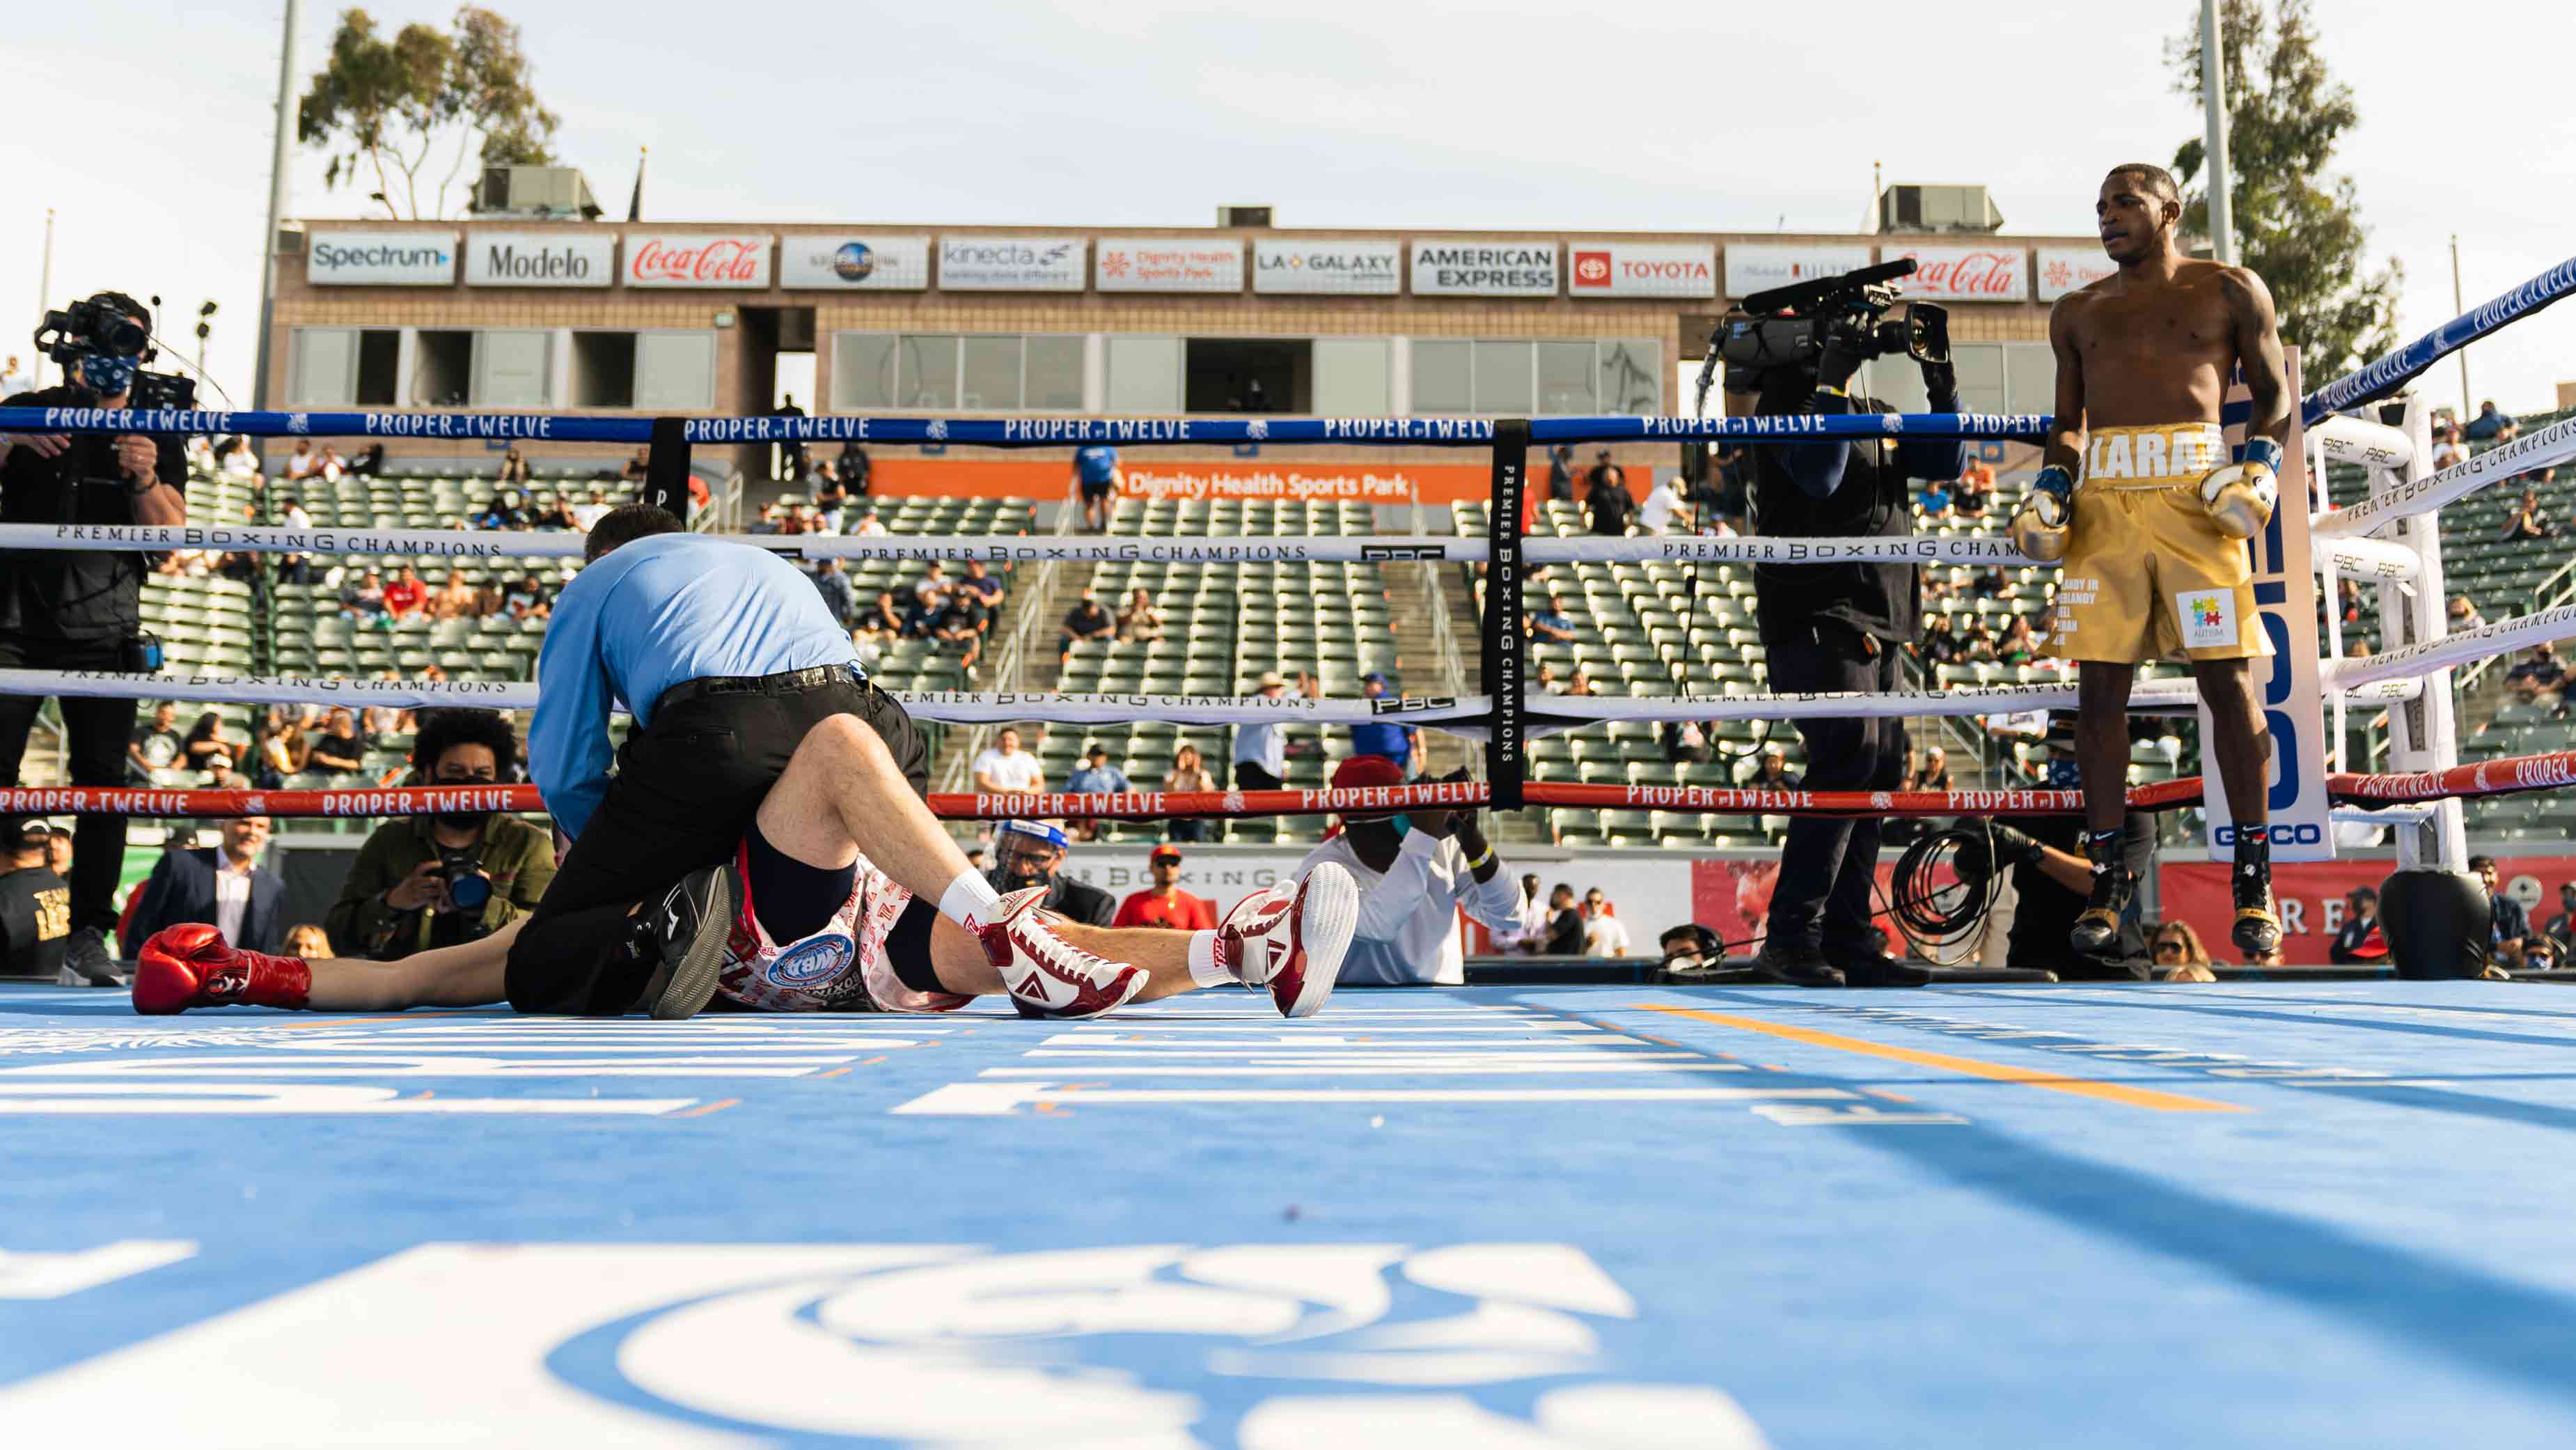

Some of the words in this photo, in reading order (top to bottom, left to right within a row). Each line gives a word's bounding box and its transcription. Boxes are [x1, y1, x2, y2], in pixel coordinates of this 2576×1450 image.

[314, 244, 440, 270] Spectrum
[487, 244, 590, 279] Modelo
[943, 241, 1035, 265] kinecta
[1258, 255, 1286, 271] LA
[1308, 255, 1395, 271] GALAXY
[1418, 249, 1552, 267] AMERICAN
[1437, 270, 1555, 287] EXPRESS
[1621, 262, 1709, 279] TOYOTA
[45, 408, 133, 430] PROPER
[144, 411, 232, 432] TWELVE
[366, 413, 452, 435] PROPER
[464, 415, 551, 437] TWELVE
[684, 418, 770, 441] PROPER
[782, 417, 870, 439] TWELVE
[1004, 418, 1091, 439] PROPER
[1103, 418, 1191, 439] TWELVE
[1324, 418, 1411, 437] PROPER
[1421, 418, 1495, 439] TWELV
[1642, 416, 1728, 435] PROPER
[1741, 414, 1826, 434] TWELVE
[1957, 412, 2041, 433] PROPER
[1129, 472, 1207, 499] Dignity
[1211, 472, 1285, 495] Health
[1288, 474, 1360, 499] Sports
[1364, 474, 1408, 495] Park
[2405, 457, 2483, 500] BOXING
[1500, 465, 1516, 540] PREMIER
[56, 524, 170, 543] PREMIER
[184, 528, 335, 550] BOXING
[348, 536, 501, 556] CHAMPIONS
[862, 547, 974, 559] PREMIER
[989, 545, 1140, 559] BOXING
[1152, 545, 1306, 559] CHAMPIONS
[1663, 544, 1775, 558] PREMIER
[1789, 540, 1937, 559] BOXING
[1499, 547, 1515, 650] BOXING
[2500, 605, 2576, 634] CHAMPIO
[354, 679, 507, 693] CHAMPIONS
[1160, 695, 1317, 710] CHAMPIONS
[1501, 657, 1514, 763] CHAMPIONS
[2516, 756, 2568, 786] PROPER
[0, 789, 87, 813] PROPER
[100, 792, 188, 814] TWELVE
[323, 791, 412, 814] PROPER
[424, 790, 514, 813] TWELVE
[976, 793, 1065, 815] PROPER
[1076, 791, 1166, 814] TWELVE
[1302, 786, 1390, 809] PROPER
[1401, 781, 1490, 804] TWELVE
[1627, 785, 1715, 806] PROPER
[1727, 788, 1814, 808] TWELVE
[1949, 790, 2034, 809] PROPER
[2215, 824, 2320, 845] GCO
[785, 946, 838, 976] WBA
